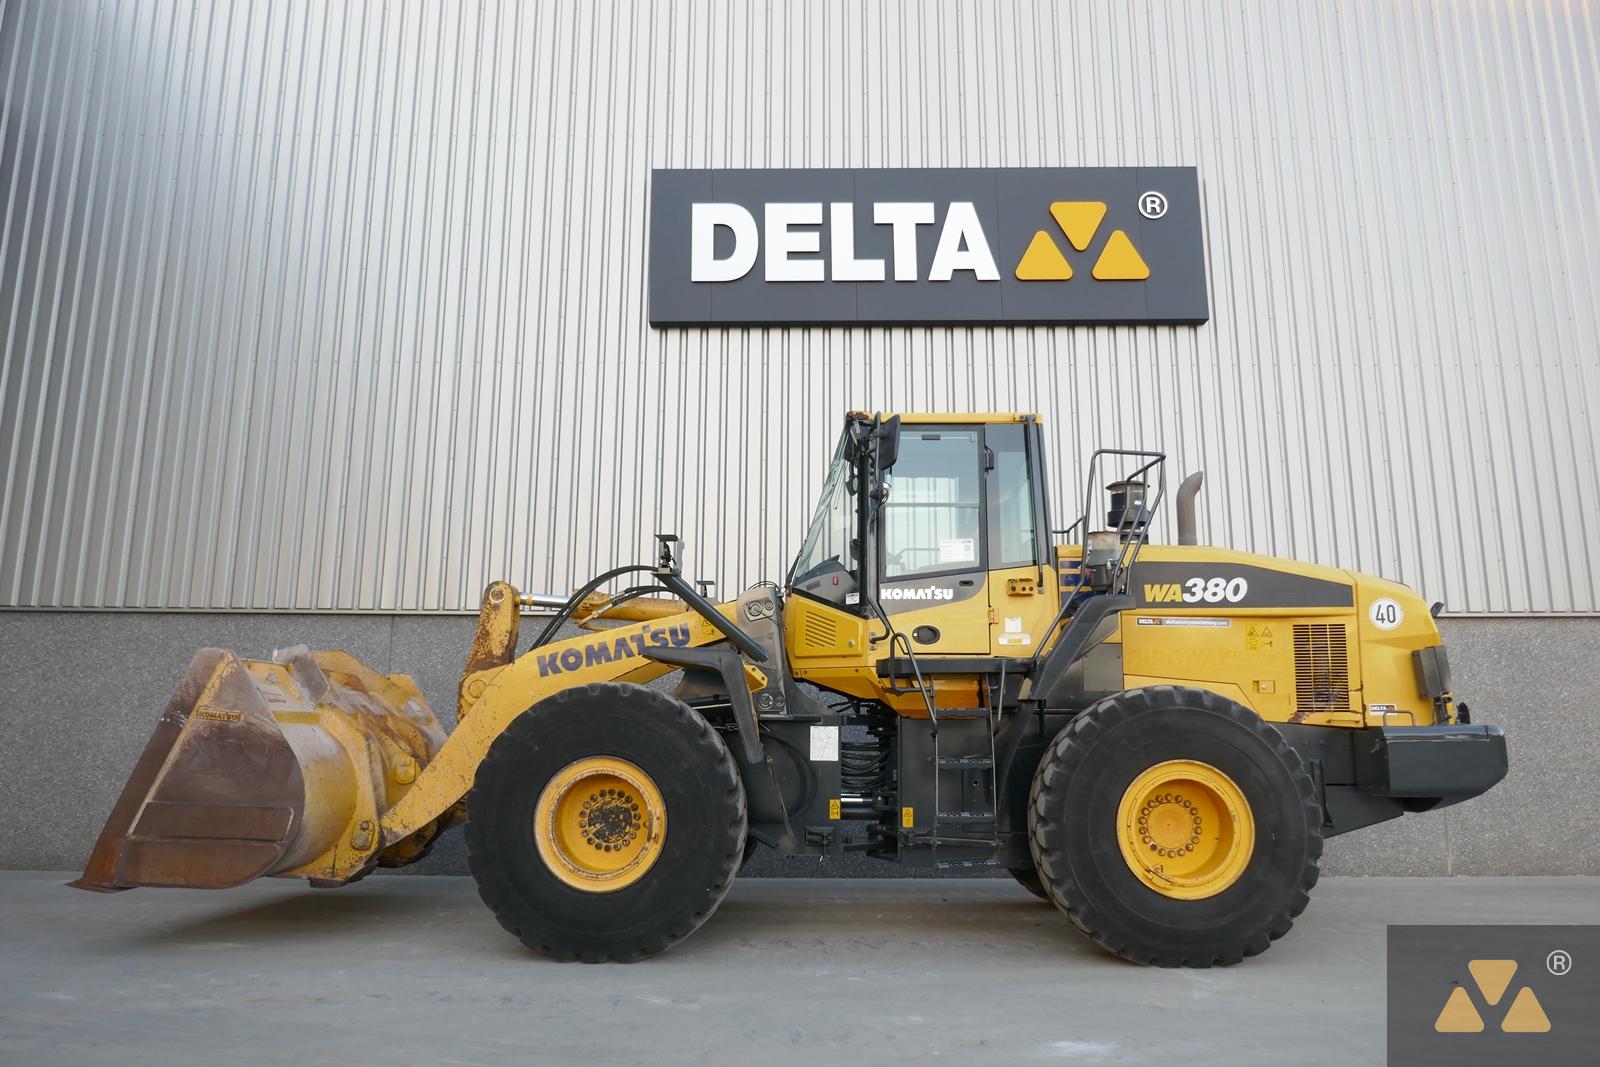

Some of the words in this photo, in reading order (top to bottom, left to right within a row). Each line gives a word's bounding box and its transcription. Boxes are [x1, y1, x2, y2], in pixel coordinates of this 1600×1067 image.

[691, 202, 1000, 282] DELTA
[881, 585, 953, 600] KOMATSU
[1144, 577, 1248, 603] WA380
[1375, 604, 1396, 623] 40
[537, 623, 691, 677] KOMATSU
